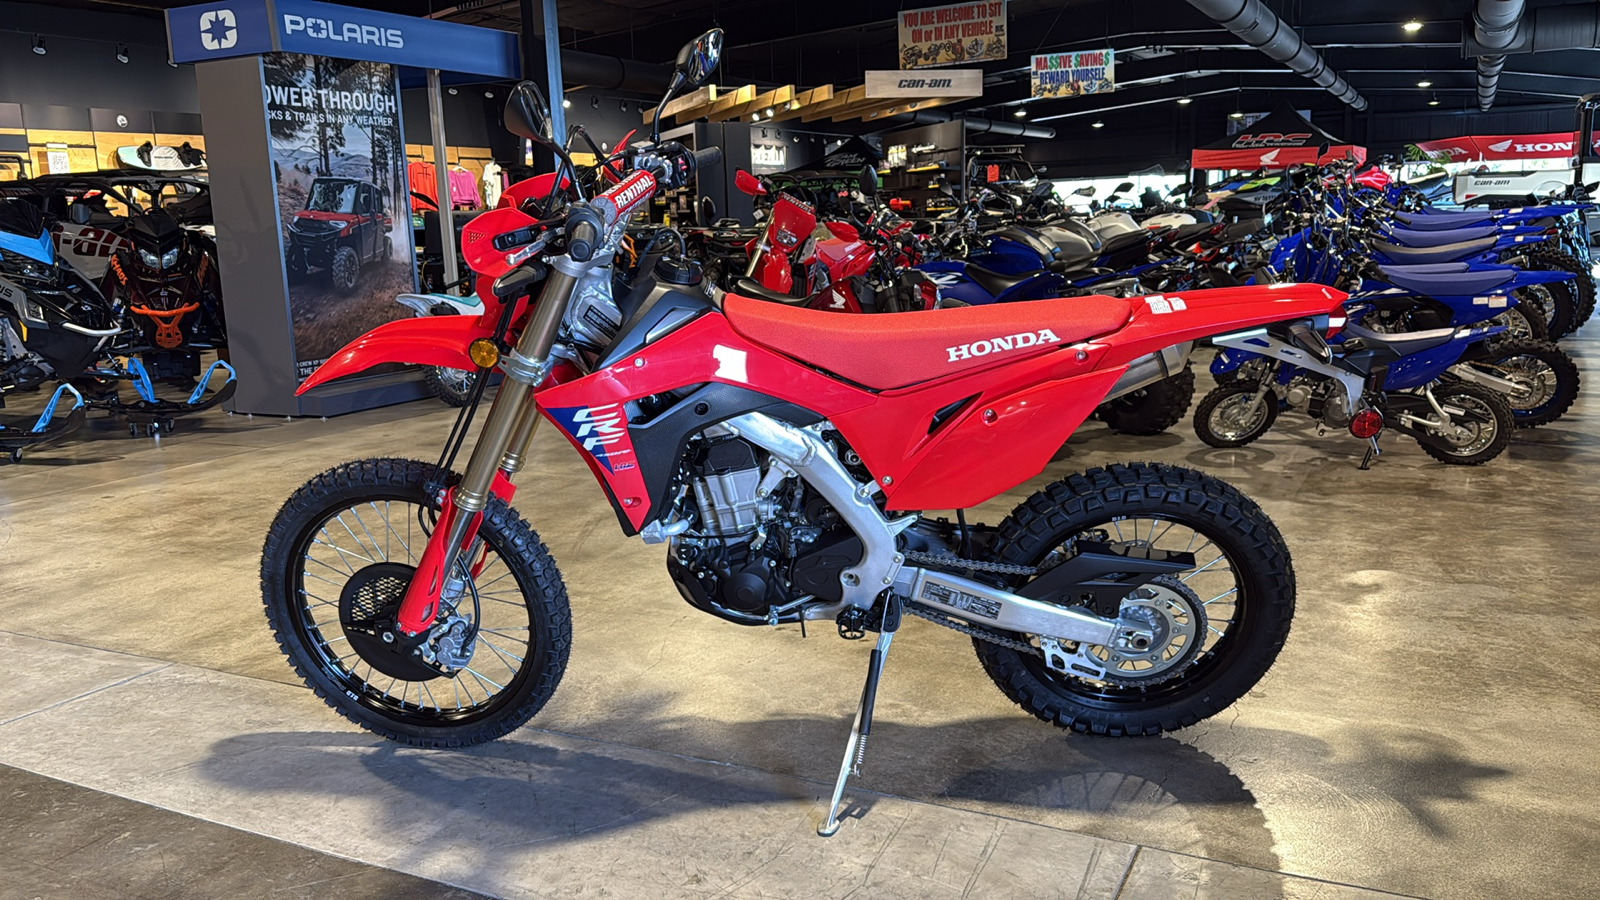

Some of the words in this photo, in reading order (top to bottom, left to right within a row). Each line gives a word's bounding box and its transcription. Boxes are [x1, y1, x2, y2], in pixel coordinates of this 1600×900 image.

[903, 12, 919, 28] YOU
[920, 10, 935, 26] ARE
[936, 6, 975, 23] WELCOME
[976, 4, 988, 18] TO
[988, 2, 1002, 17] SIT
[283, 13, 404, 49] POLARIS
[912, 29, 923, 43] ON
[924, 30, 933, 42] or
[934, 25, 943, 41] IN
[944, 24, 960, 40] ANY
[961, 20, 993, 38] VEHICLE
[1040, 70, 1070, 85] REWARD
[1071, 67, 1106, 82] YOURSELF
[318, 89, 396, 113] THROUGH
[284, 111, 292, 121] &
[294, 111, 325, 124] TRAILS
[325, 114, 336, 124] IN
[337, 114, 355, 124] ANY
[355, 114, 394, 127] WEATHER
[614, 175, 654, 209] RENTHAL
[946, 328, 1061, 362] HONDA
[300, 367, 313, 375] THE
[572, 402, 626, 451] CRF
